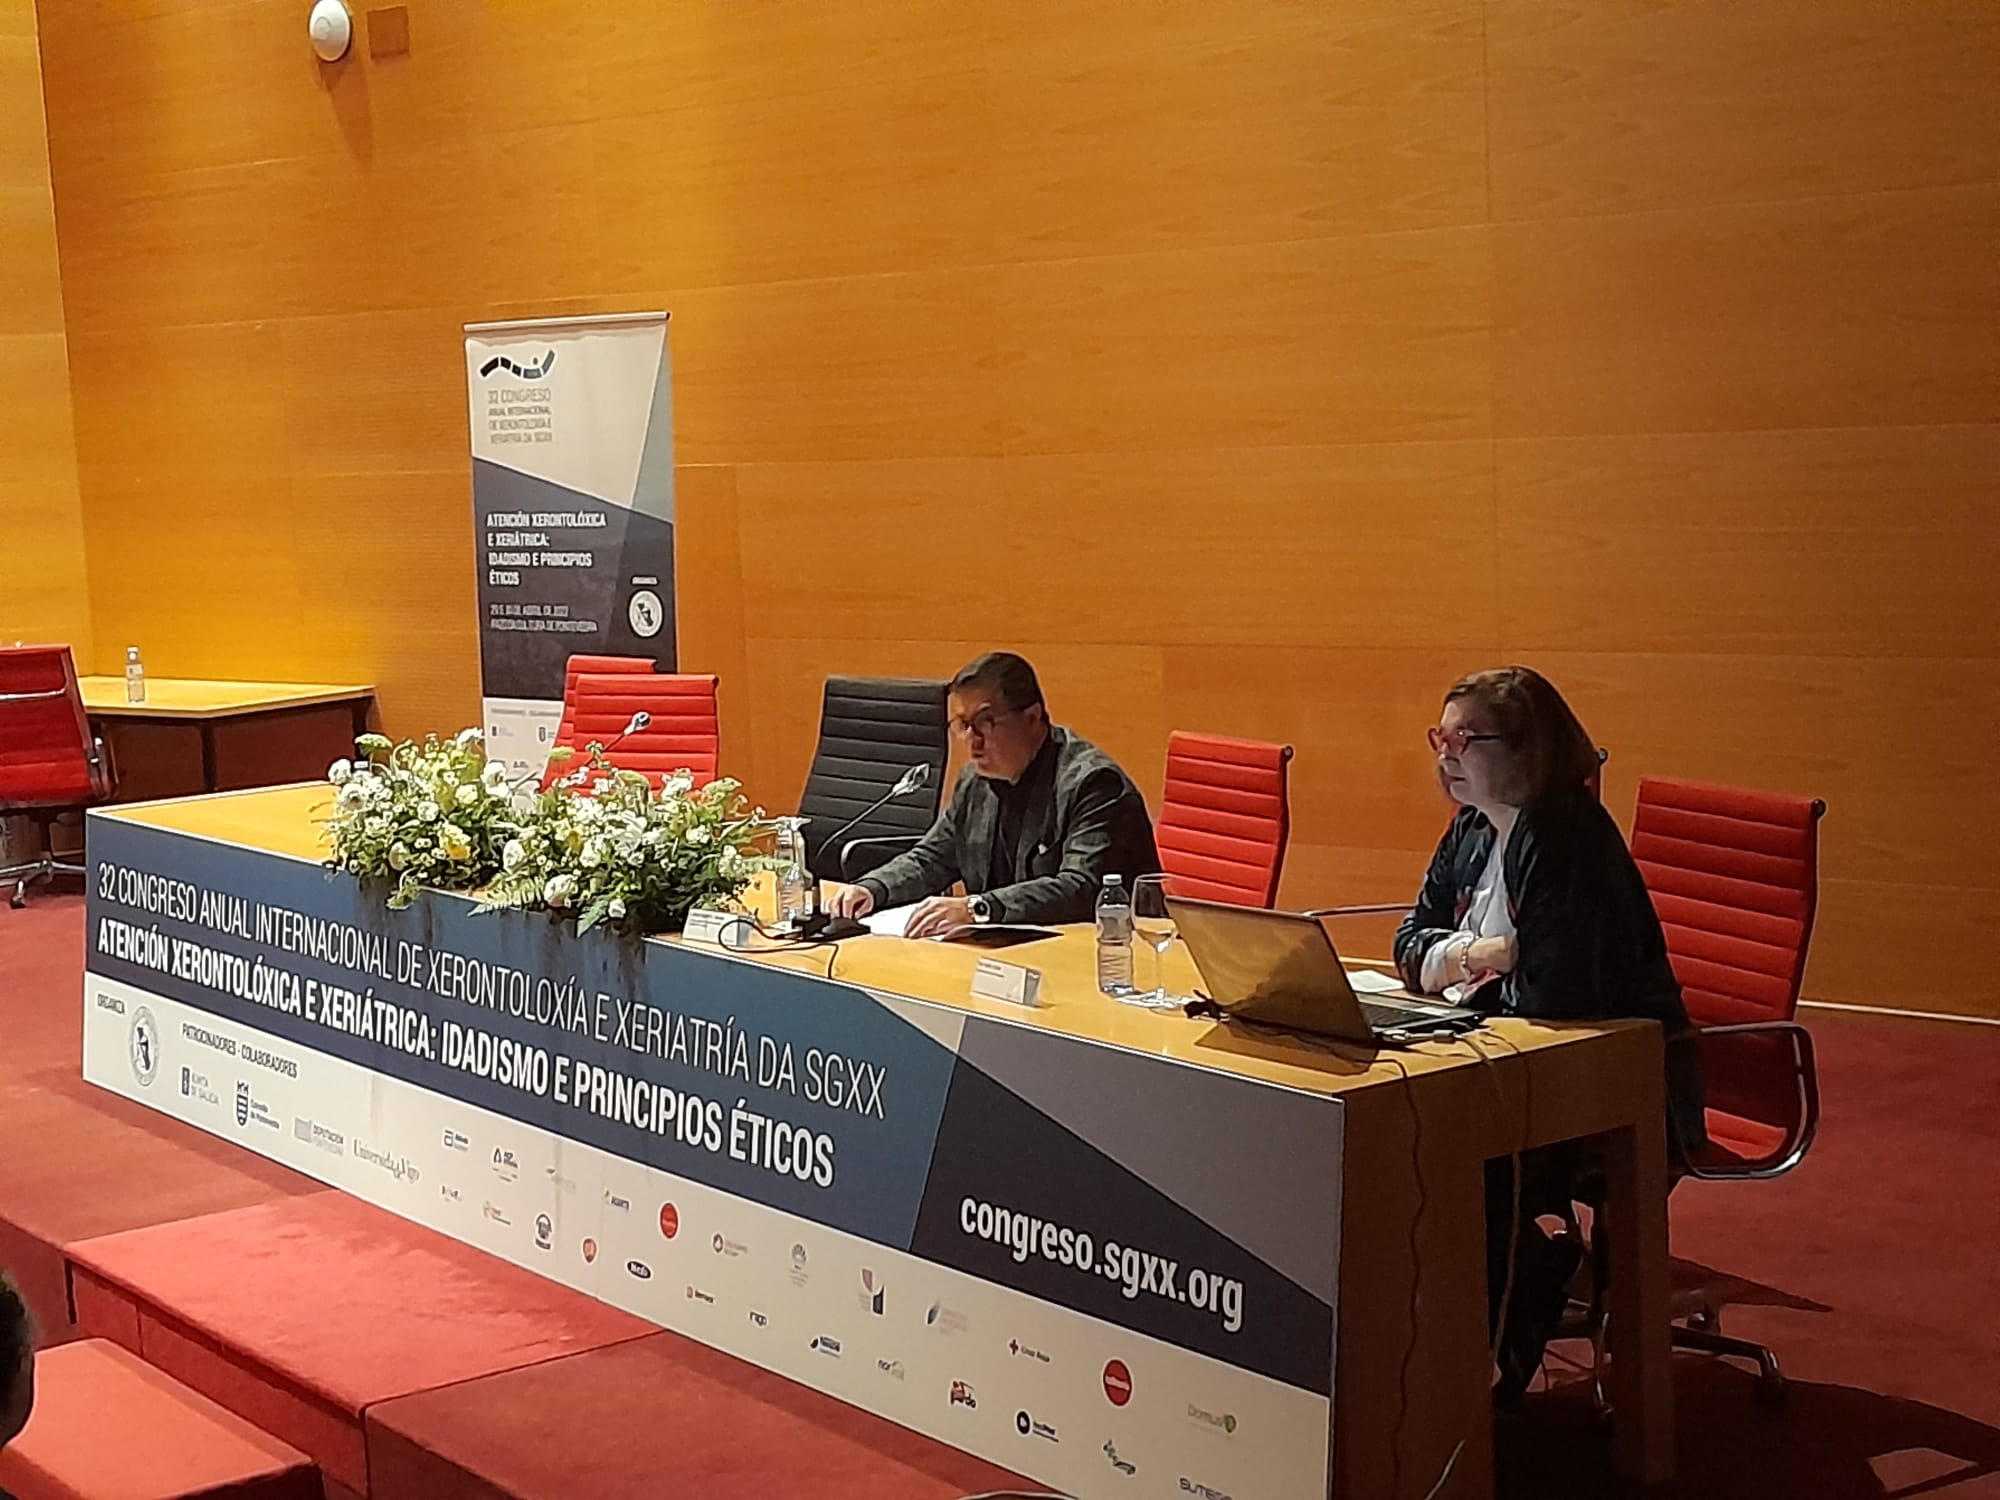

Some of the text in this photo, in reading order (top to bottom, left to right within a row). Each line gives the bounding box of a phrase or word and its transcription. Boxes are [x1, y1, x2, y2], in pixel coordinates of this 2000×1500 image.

[487, 510, 607, 528] ATENCIÓN XERONTOLÓXICA
[488, 533, 495, 547] E
[489, 568, 520, 586] ÉTICOS
[532, 552, 540, 567] E
[540, 552, 593, 567] PRINCIPIOS
[98, 862, 886, 1120] 32 CONGRESO ANUAL INTERNACIONAL DE XERONTOLOXÍA E XERIATRÍA DA SGXX
[97, 917, 834, 1188] ATENCIÓN XERONTOLÓXICA E XERIÁTRICA: IDADISMO E PRINCIPIOS ÉTICOS
[182, 1022, 237, 1057] PATROCINADORES
[240, 1043, 299, 1079] COLABORADORES
[960, 1197, 1243, 1332] congreso.sgxx.org
